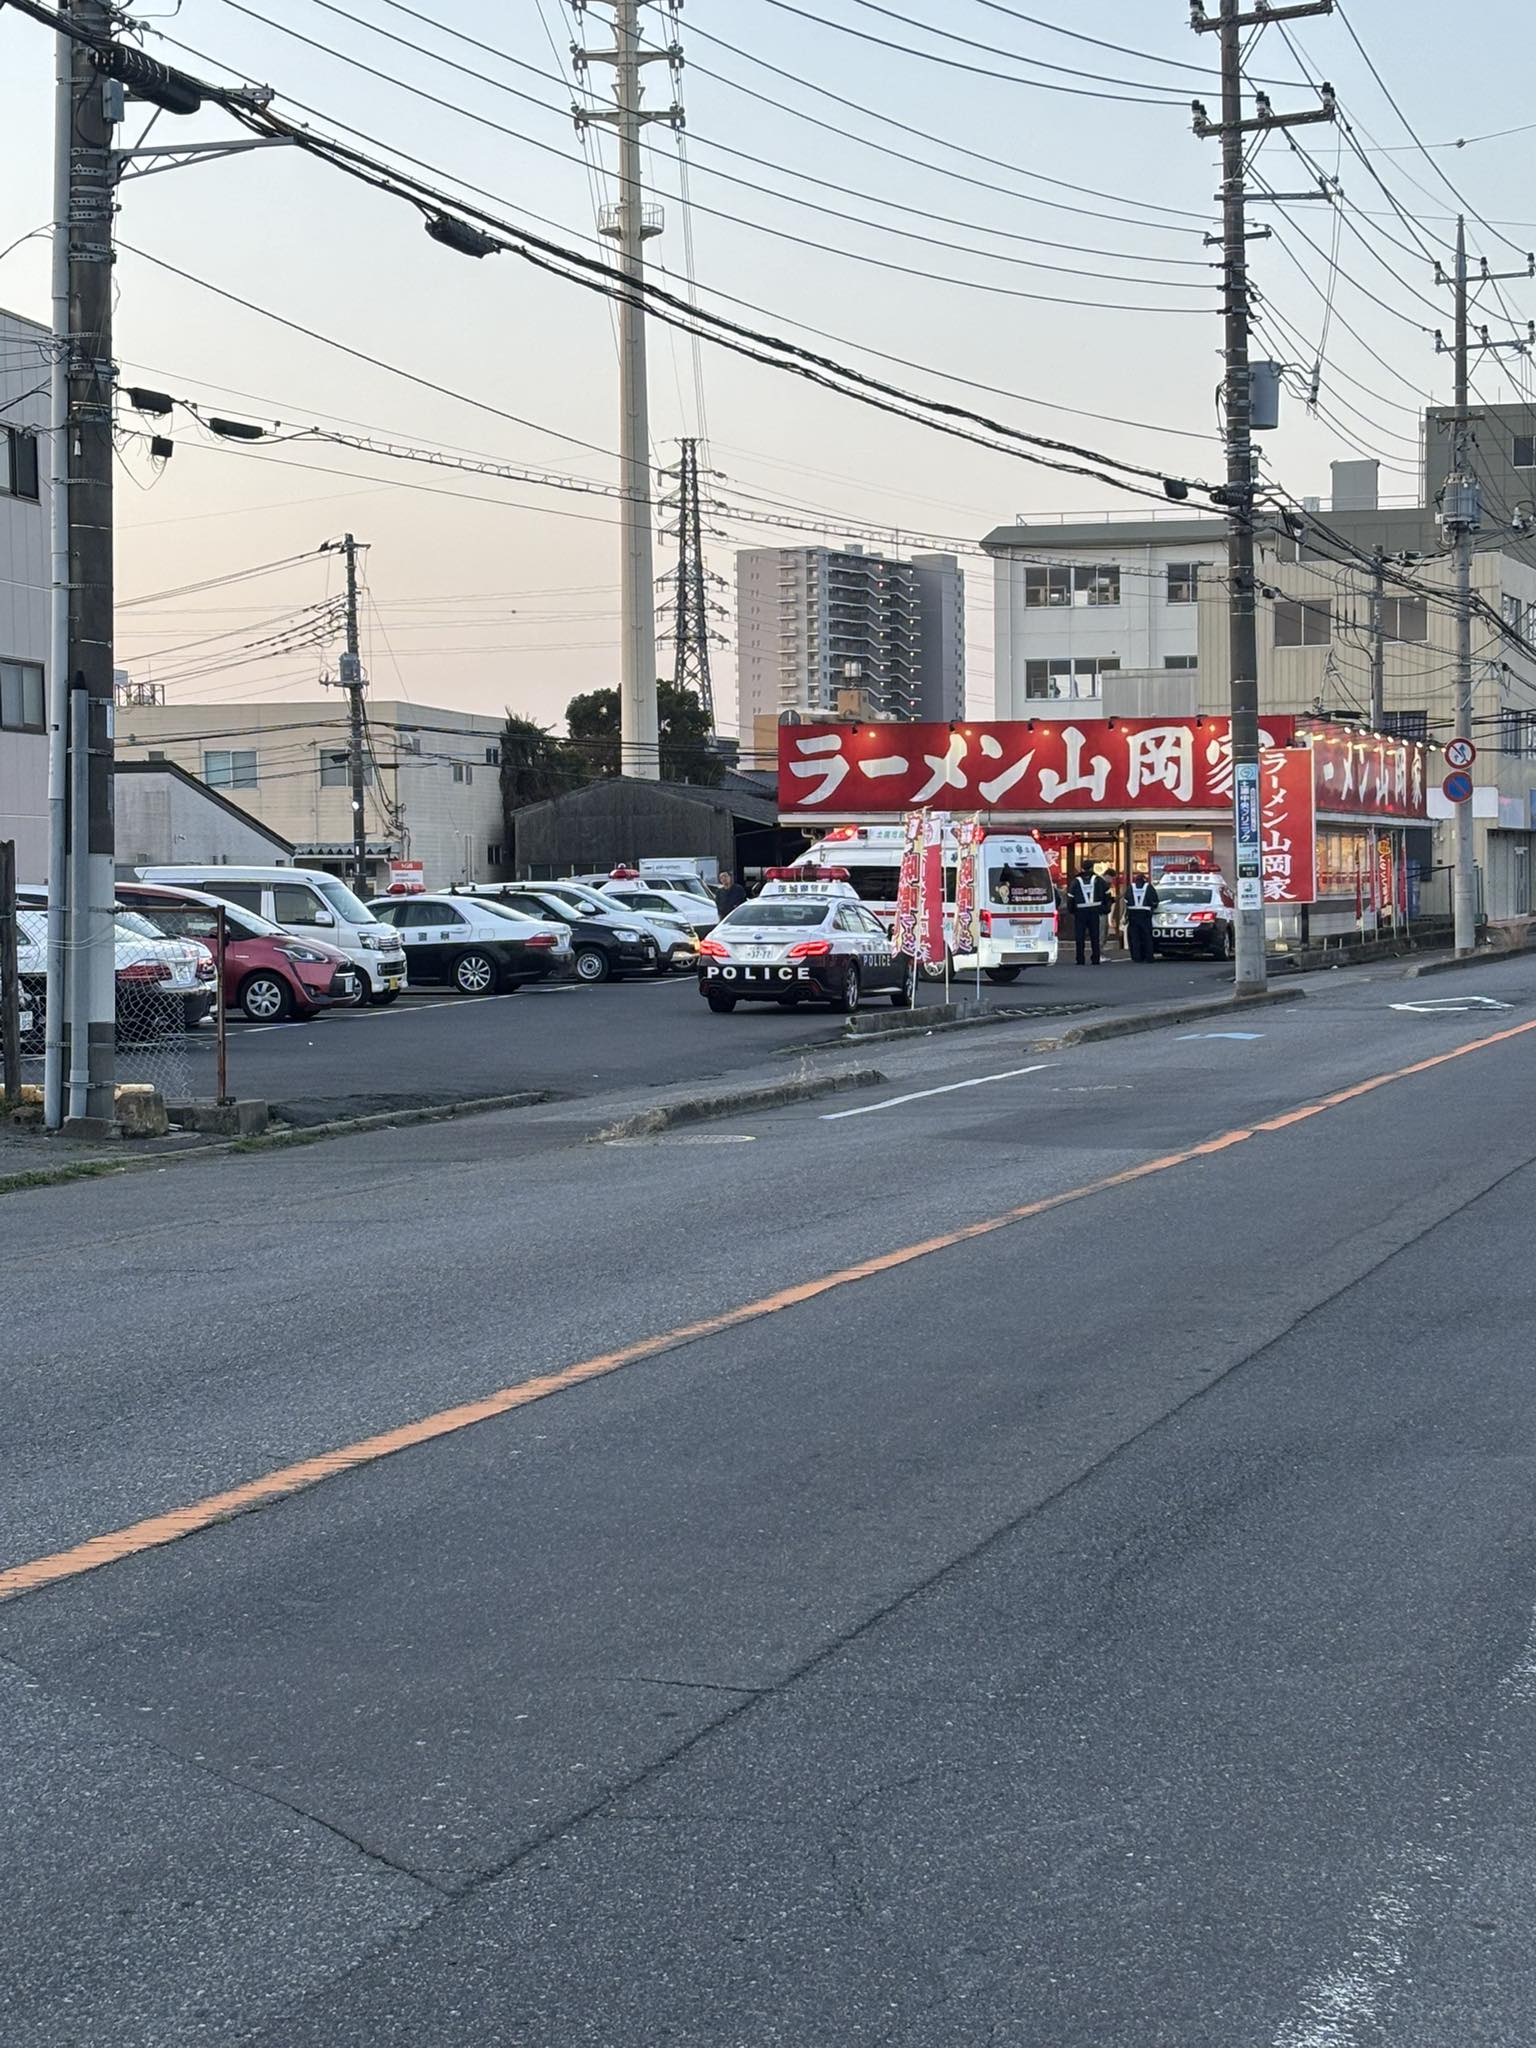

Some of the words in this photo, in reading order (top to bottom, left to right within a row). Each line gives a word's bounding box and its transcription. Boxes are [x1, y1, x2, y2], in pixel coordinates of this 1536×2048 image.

[1261, 752, 1297, 900] ラーメン山岡家
[1152, 928, 1195, 938] OLICE
[863, 954, 892, 967] POLICE
[706, 966, 811, 981] POLICE
